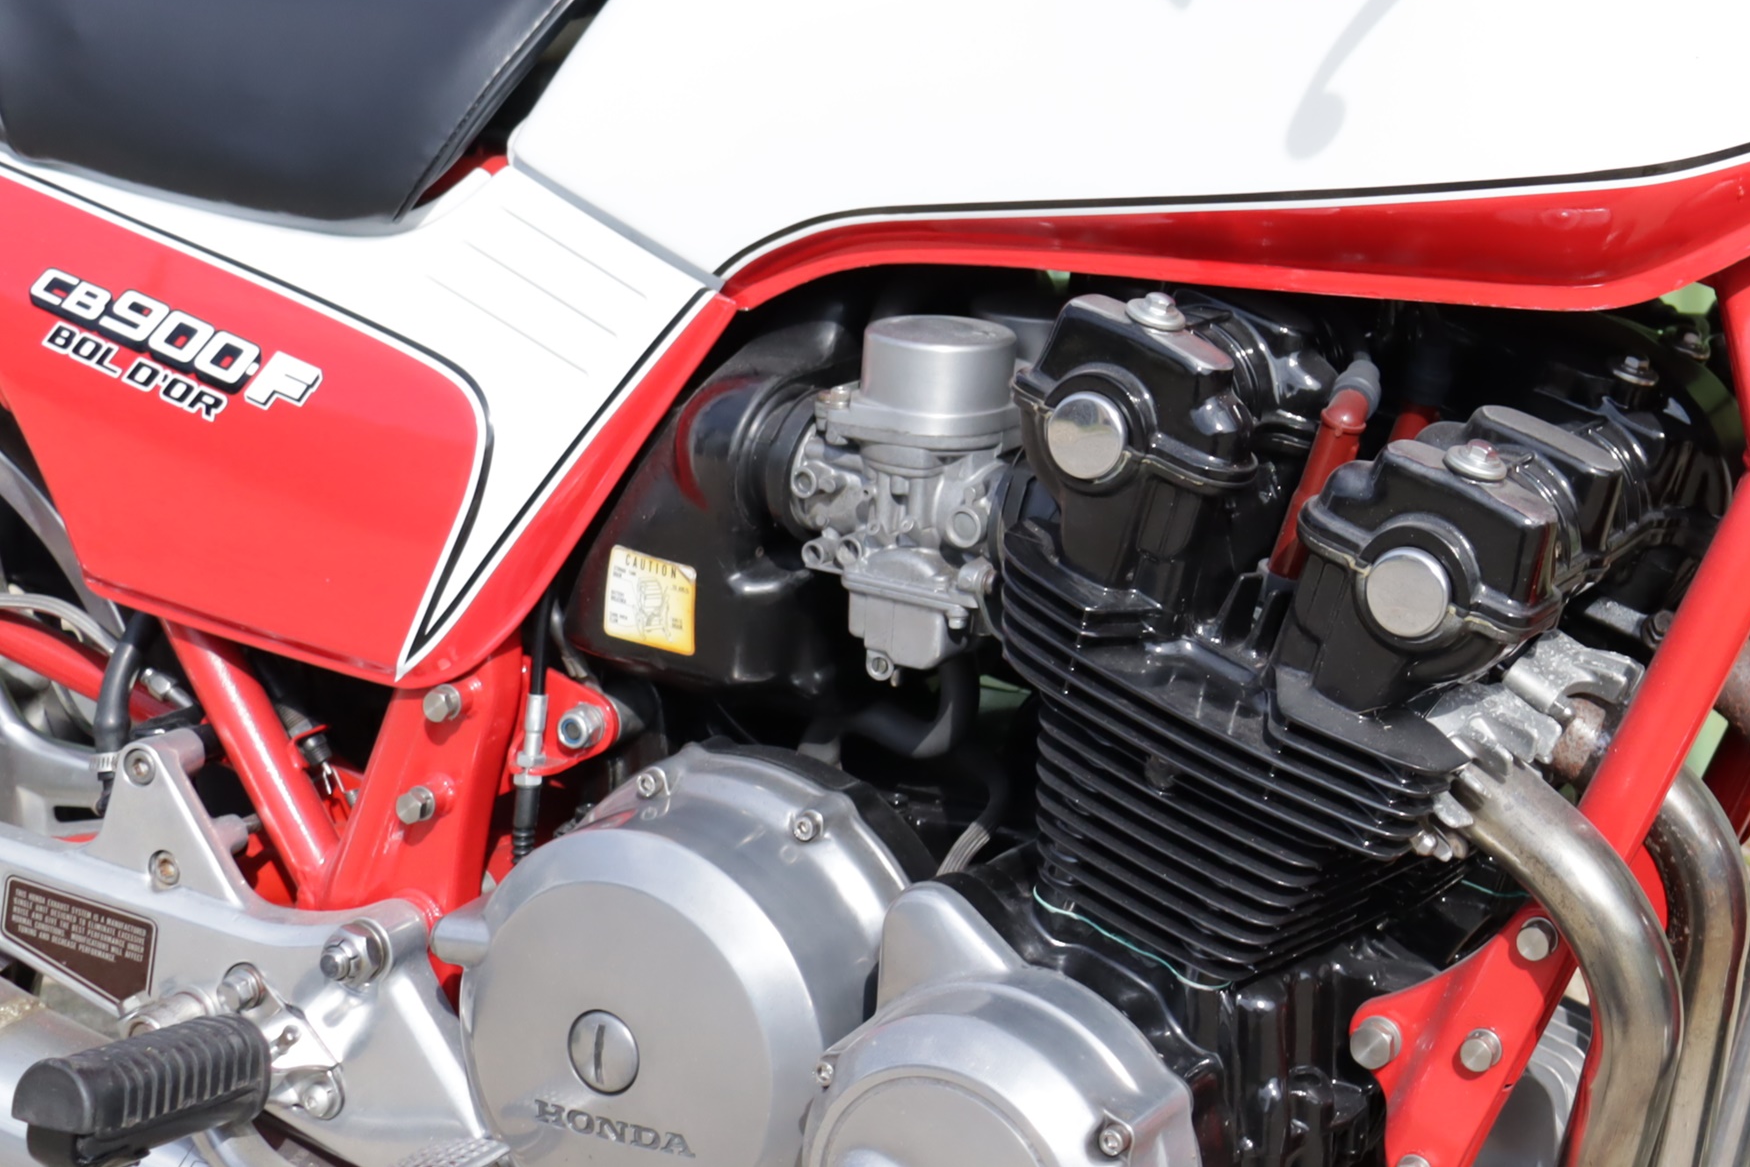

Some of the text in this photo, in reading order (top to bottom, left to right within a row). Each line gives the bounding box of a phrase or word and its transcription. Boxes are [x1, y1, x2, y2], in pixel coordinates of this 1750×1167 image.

[42, 322, 227, 422] BOL D'OR
[625, 554, 677, 579] CAUTION
[13, 897, 33, 910] SINGLE
[35, 904, 48, 914] UNIT
[50, 908, 77, 924] DESIGNED
[87, 920, 116, 936] ELIMINATE
[117, 929, 145, 945] EXCESSIVE
[13, 905, 29, 917] NOISE
[31, 911, 43, 921] AND
[59, 920, 70, 930] THE
[71, 924, 85, 934] BEST
[87, 928, 125, 949] PERFORMANCE
[126, 942, 144, 954] UNDER
[15, 888, 27, 899] THIS
[28, 893, 45, 905] HONDA
[47, 899, 70, 912] EXHAUST
[71, 906, 92, 920] SYSTEM
[106, 917, 147, 937] MANUFACTURED
[18, 924, 38, 937] TUNING
[38, 931, 50, 941] AND
[51, 935, 77, 950] DECREASE
[11, 914, 33, 927] NORMAL
[70, 933, 109, 952] MODIFICATIONS
[110, 945, 123, 956] WILL
[124, 949, 144, 963] AFFECT
[534, 1098, 696, 1159] HONDA
